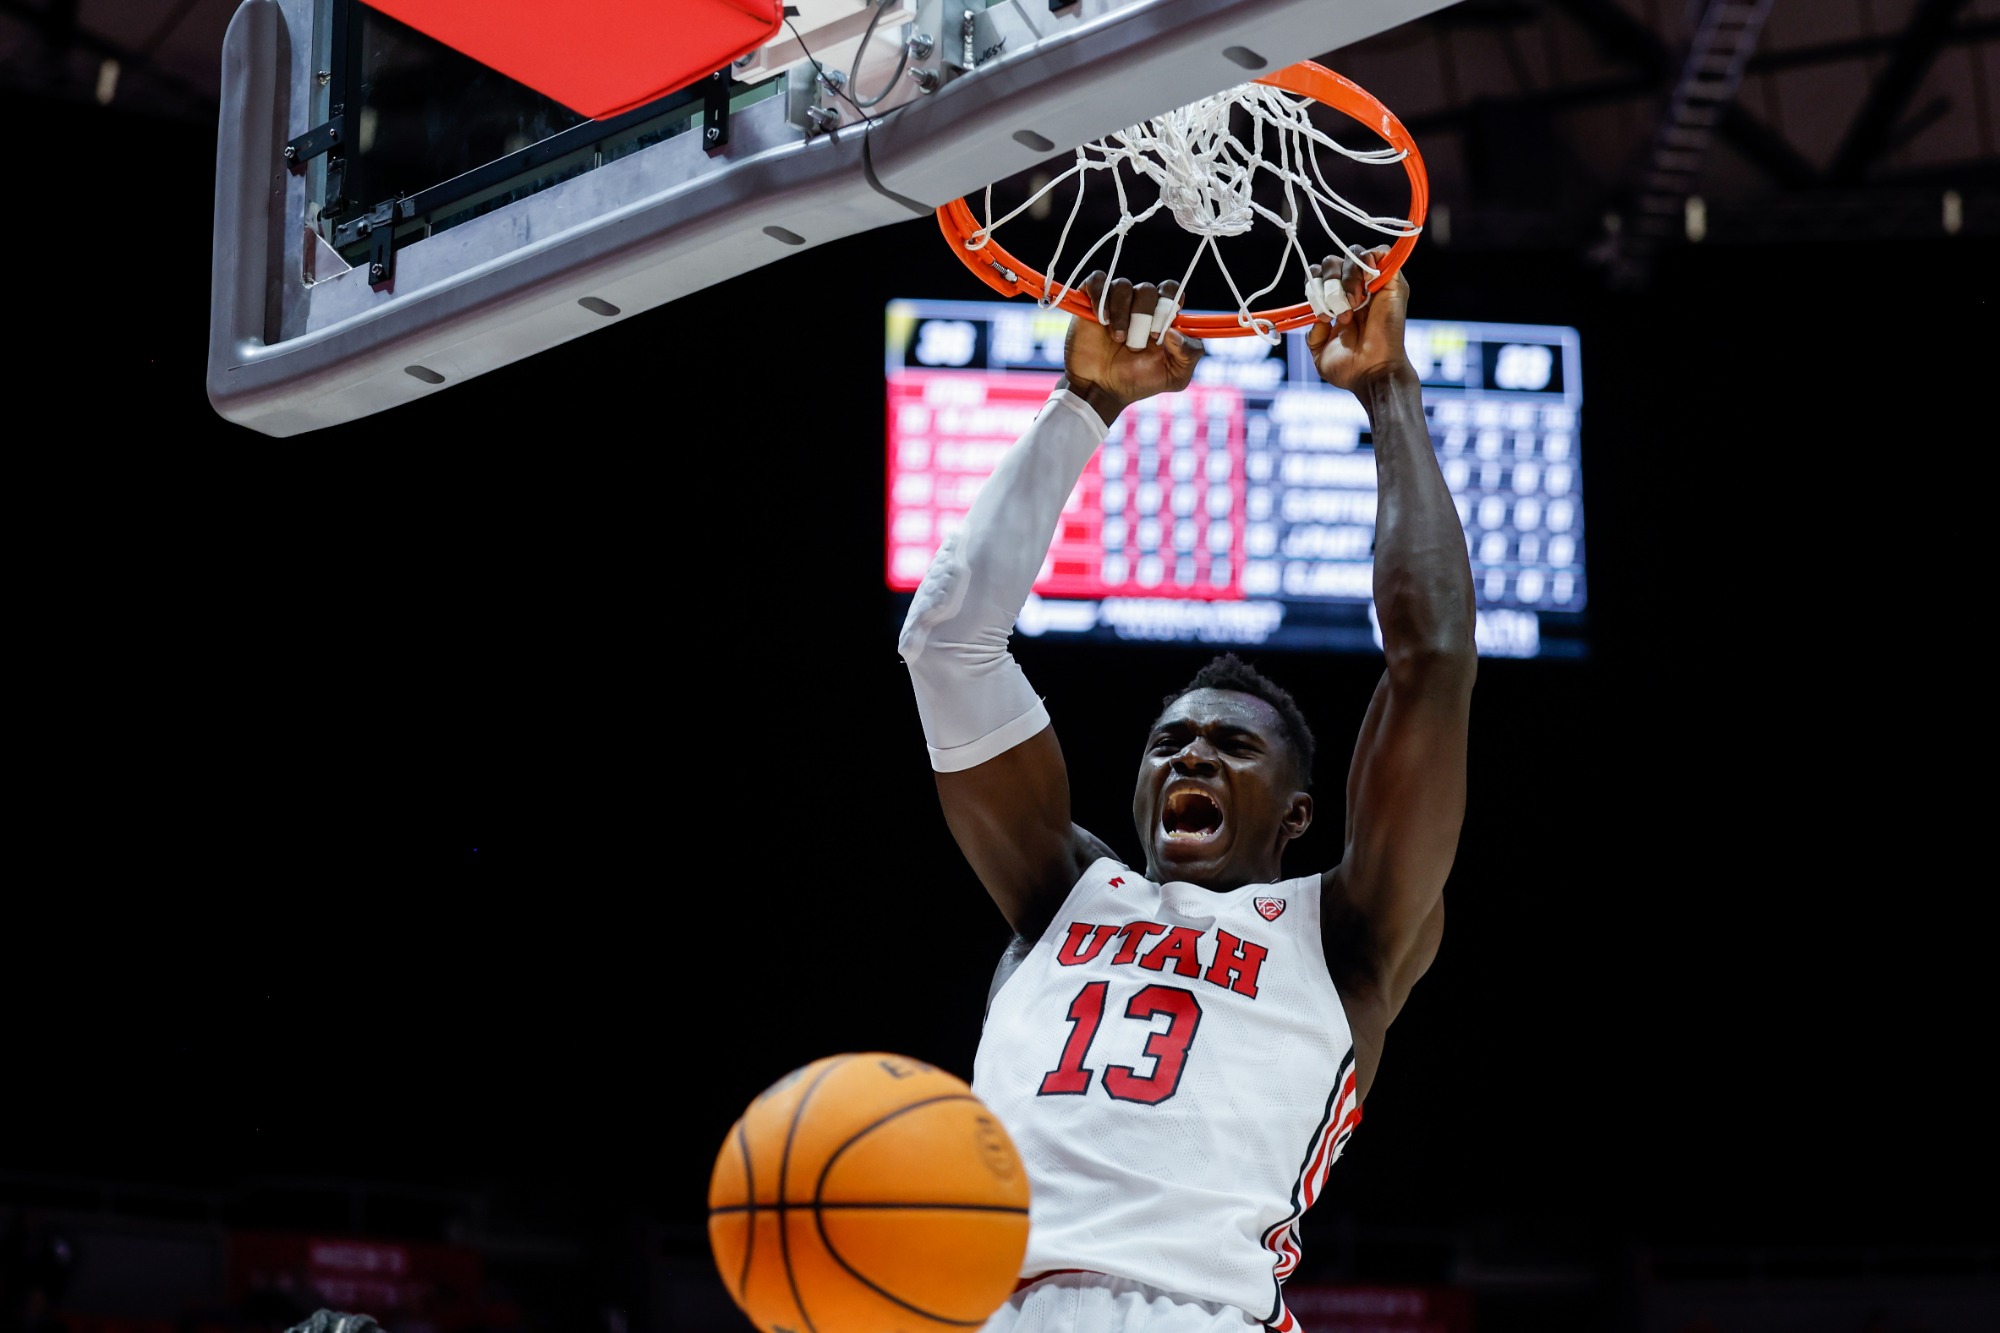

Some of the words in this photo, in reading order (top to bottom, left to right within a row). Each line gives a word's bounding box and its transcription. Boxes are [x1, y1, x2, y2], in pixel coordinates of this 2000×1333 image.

[975, 36, 1006, 67] WEST
[1263, 906, 1278, 916] 12
[1057, 921, 1268, 1000] UTAH
[1036, 980, 1203, 1106] 13
